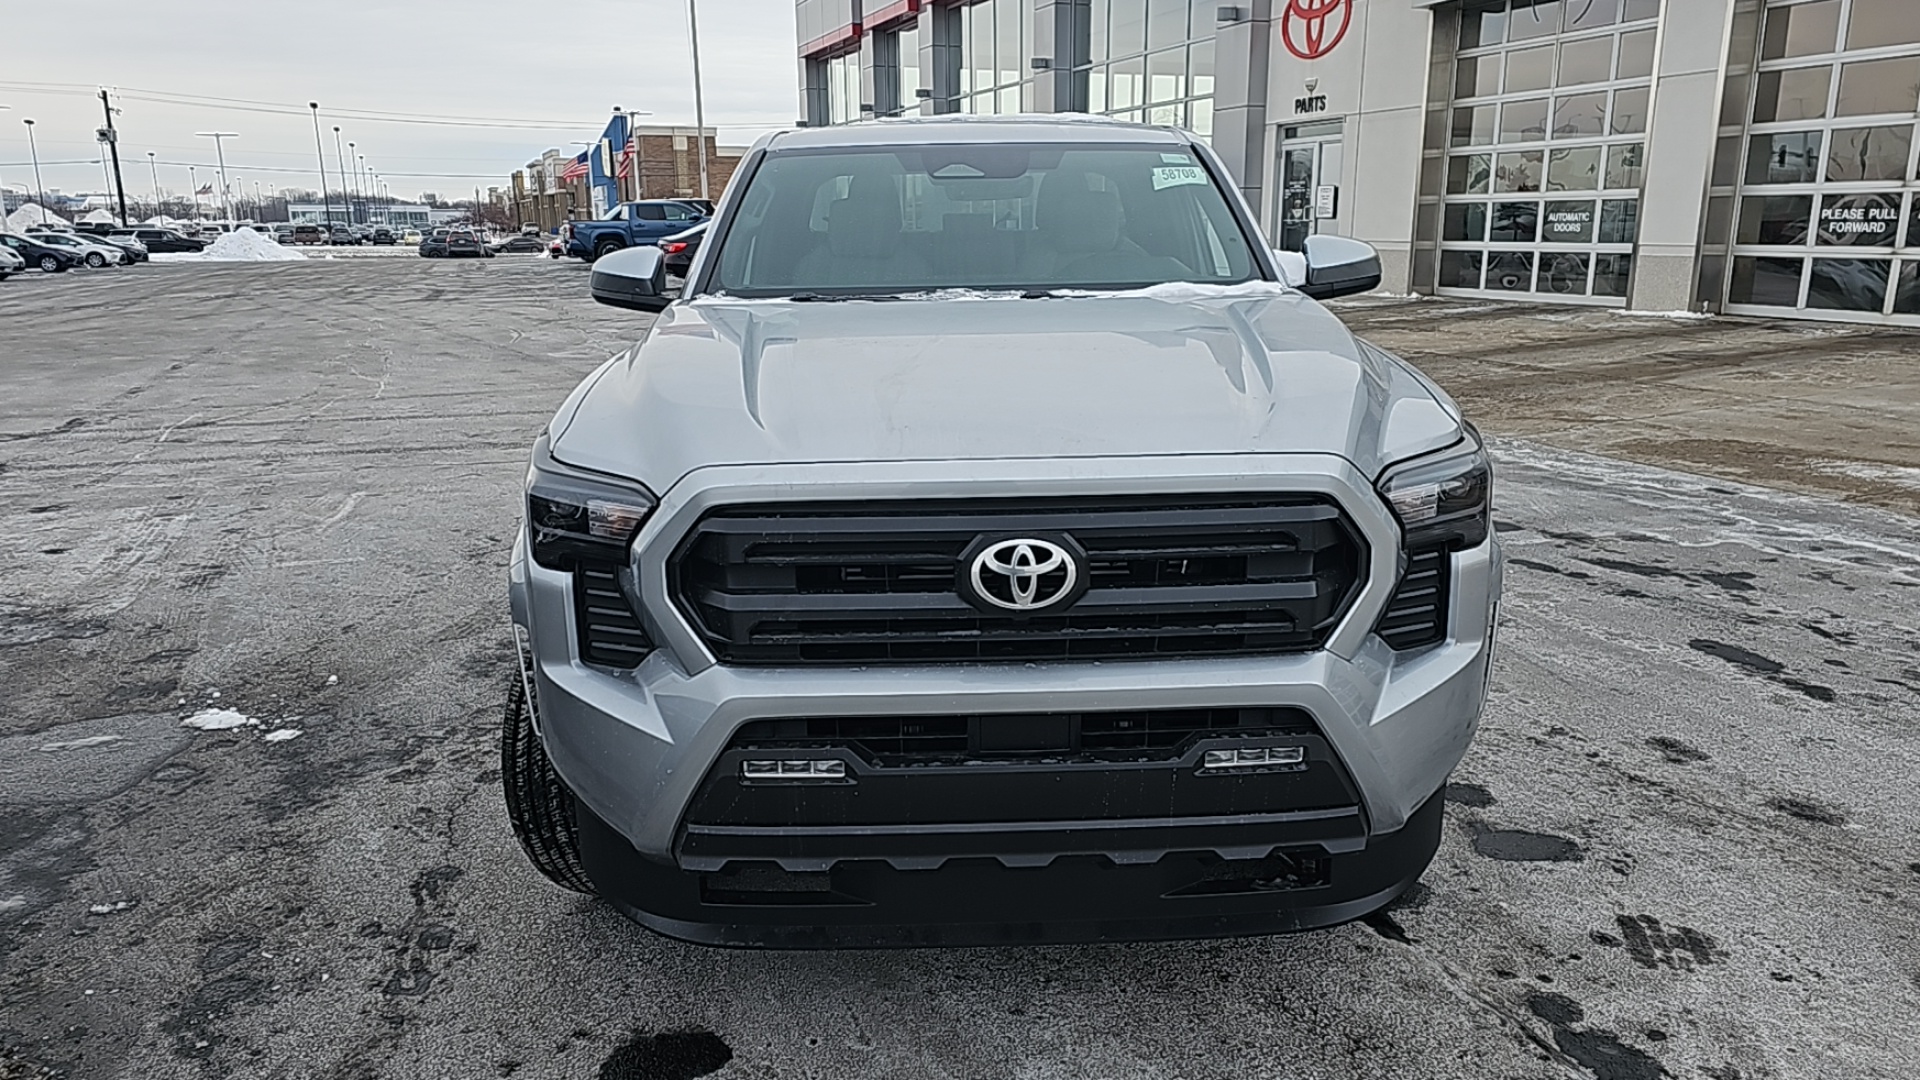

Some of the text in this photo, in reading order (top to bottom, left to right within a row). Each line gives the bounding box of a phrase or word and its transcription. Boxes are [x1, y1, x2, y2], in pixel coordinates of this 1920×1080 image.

[1295, 95, 1326, 114] PARTS
[1161, 168, 1197, 180] 58708
[1547, 212, 1590, 222] AUTOMATIC
[1821, 208, 1898, 220] PLEASE PULL
[1553, 222, 1581, 232] DOORS
[1828, 222, 1886, 233] FORWARD
